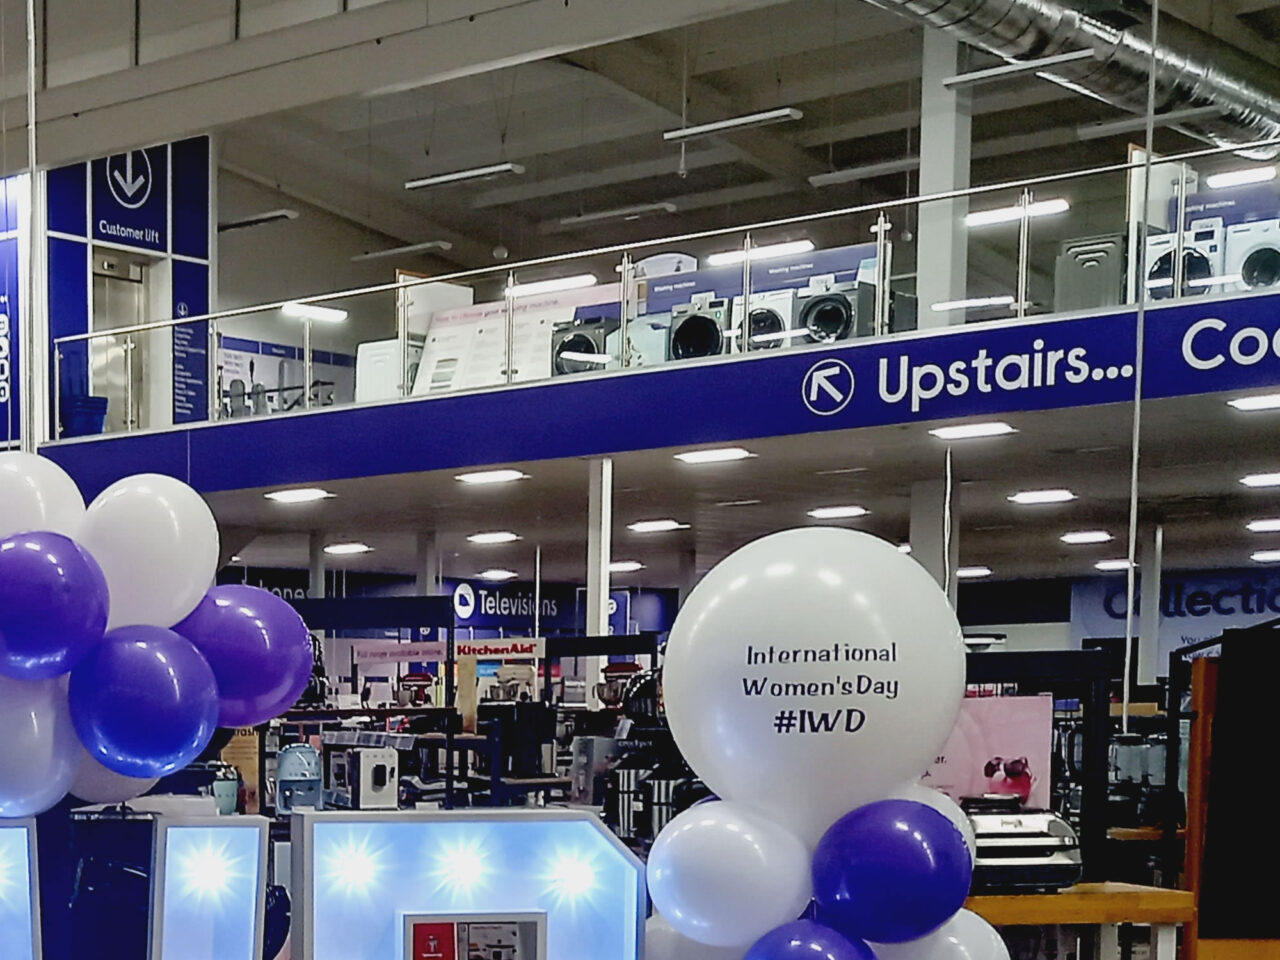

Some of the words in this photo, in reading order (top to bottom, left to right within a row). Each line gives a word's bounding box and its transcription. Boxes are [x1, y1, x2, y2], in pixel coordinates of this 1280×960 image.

[99, 220, 144, 240] Customer
[878, 338, 1134, 412] Upstairs...
[1181, 318, 1280, 370] Co
[479, 589, 558, 616] Televisins
[1104, 577, 1280, 621] Cllecti
[457, 643, 534, 656] KitchenAid
[747, 642, 897, 666] International
[742, 675, 853, 697] Women's
[856, 675, 899, 700] Day
[773, 708, 866, 734] #IWD
